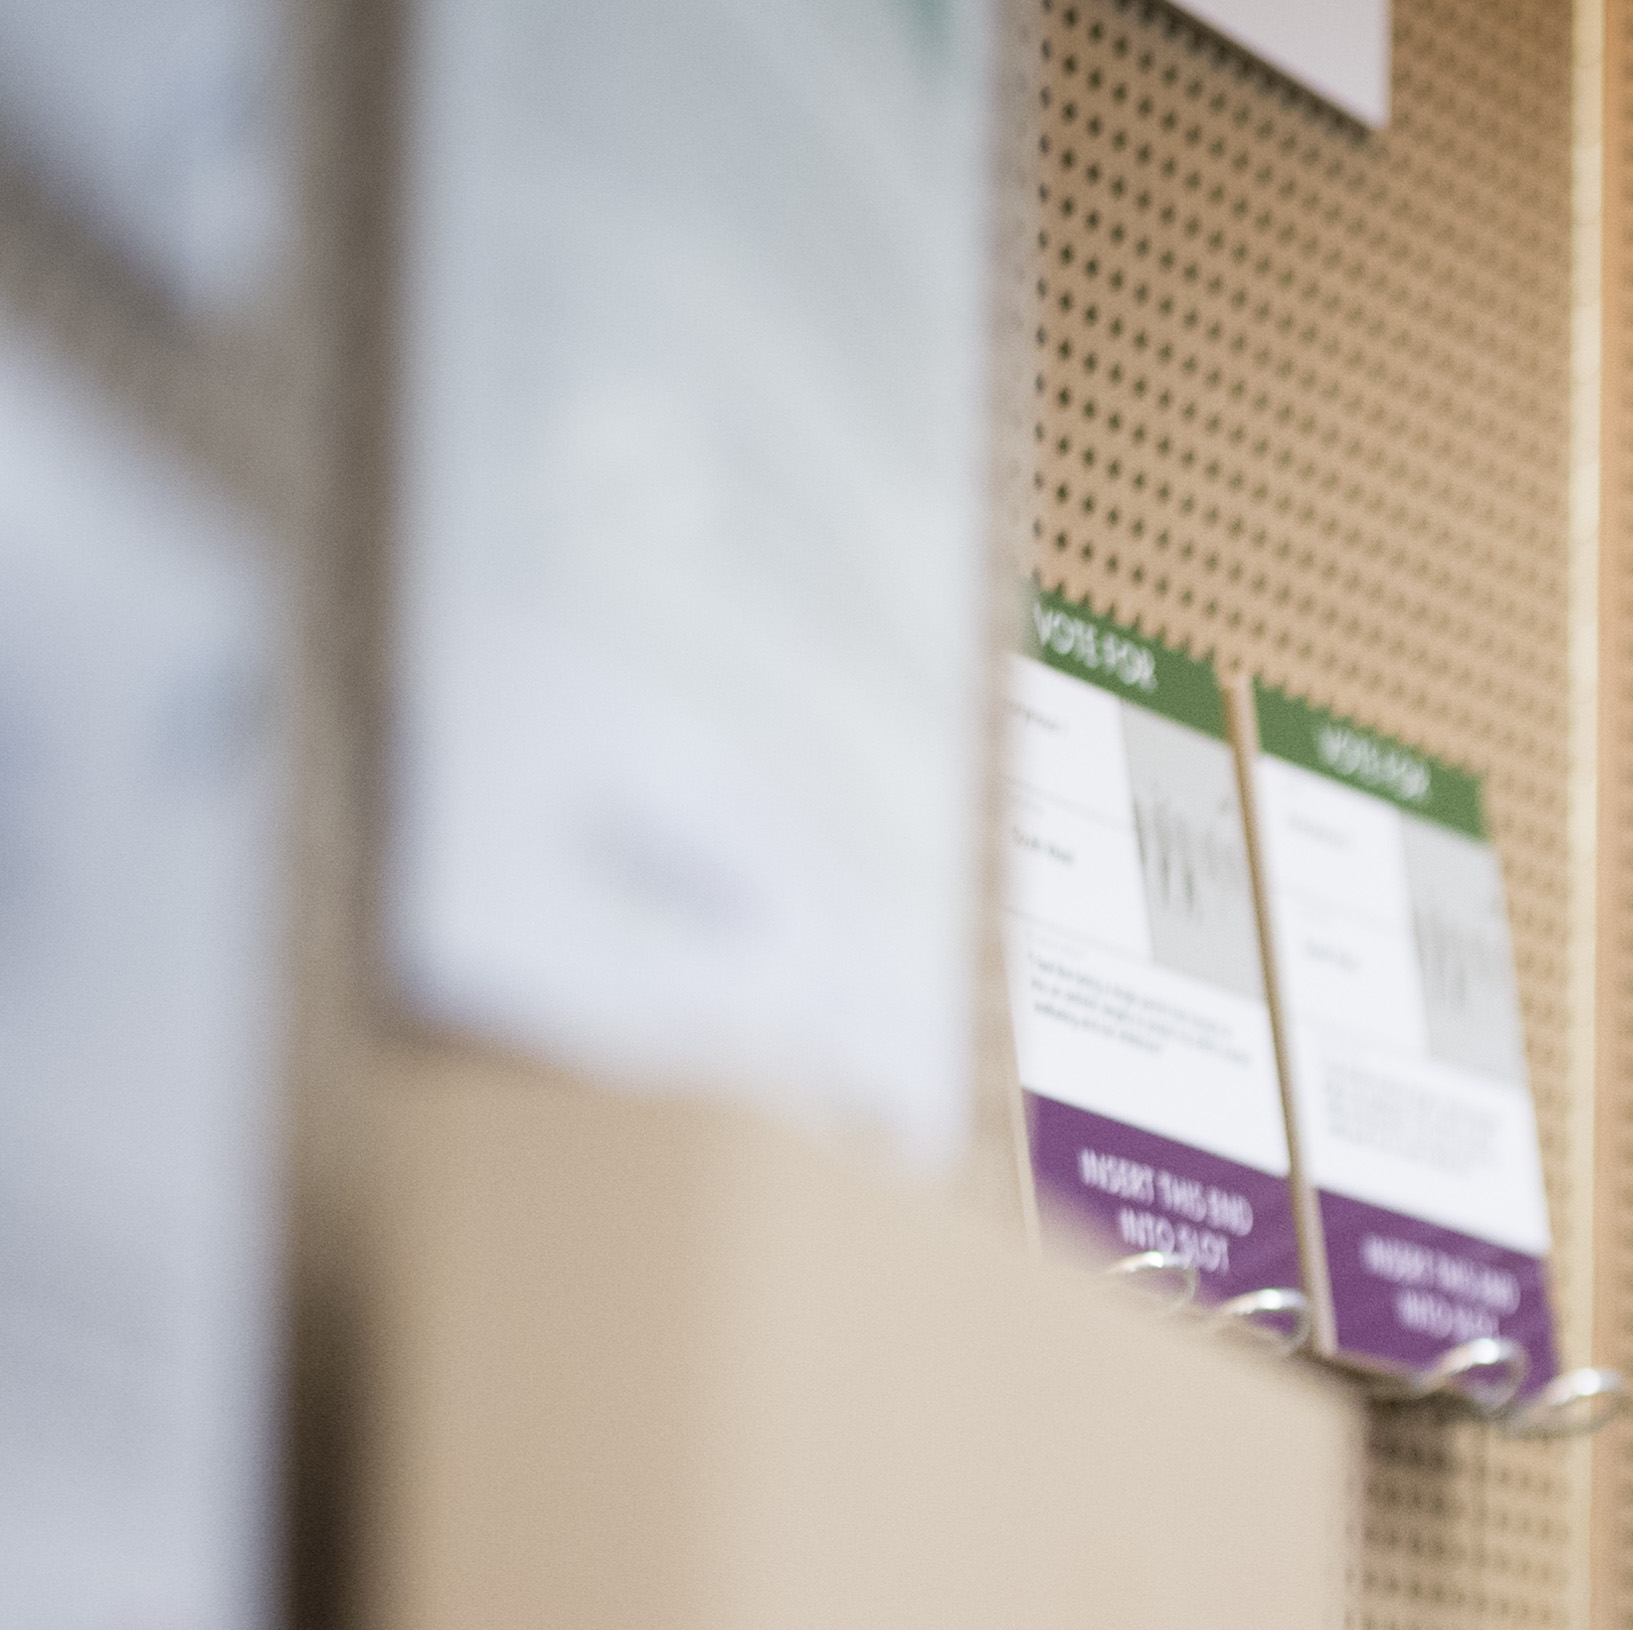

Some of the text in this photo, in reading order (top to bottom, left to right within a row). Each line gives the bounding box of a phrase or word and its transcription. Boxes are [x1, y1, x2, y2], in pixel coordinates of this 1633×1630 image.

[1033, 601, 1158, 694] VOTE FOR
[1078, 1147, 1255, 1238] INSERT THIS END
[1118, 1206, 1177, 1262] INTO
